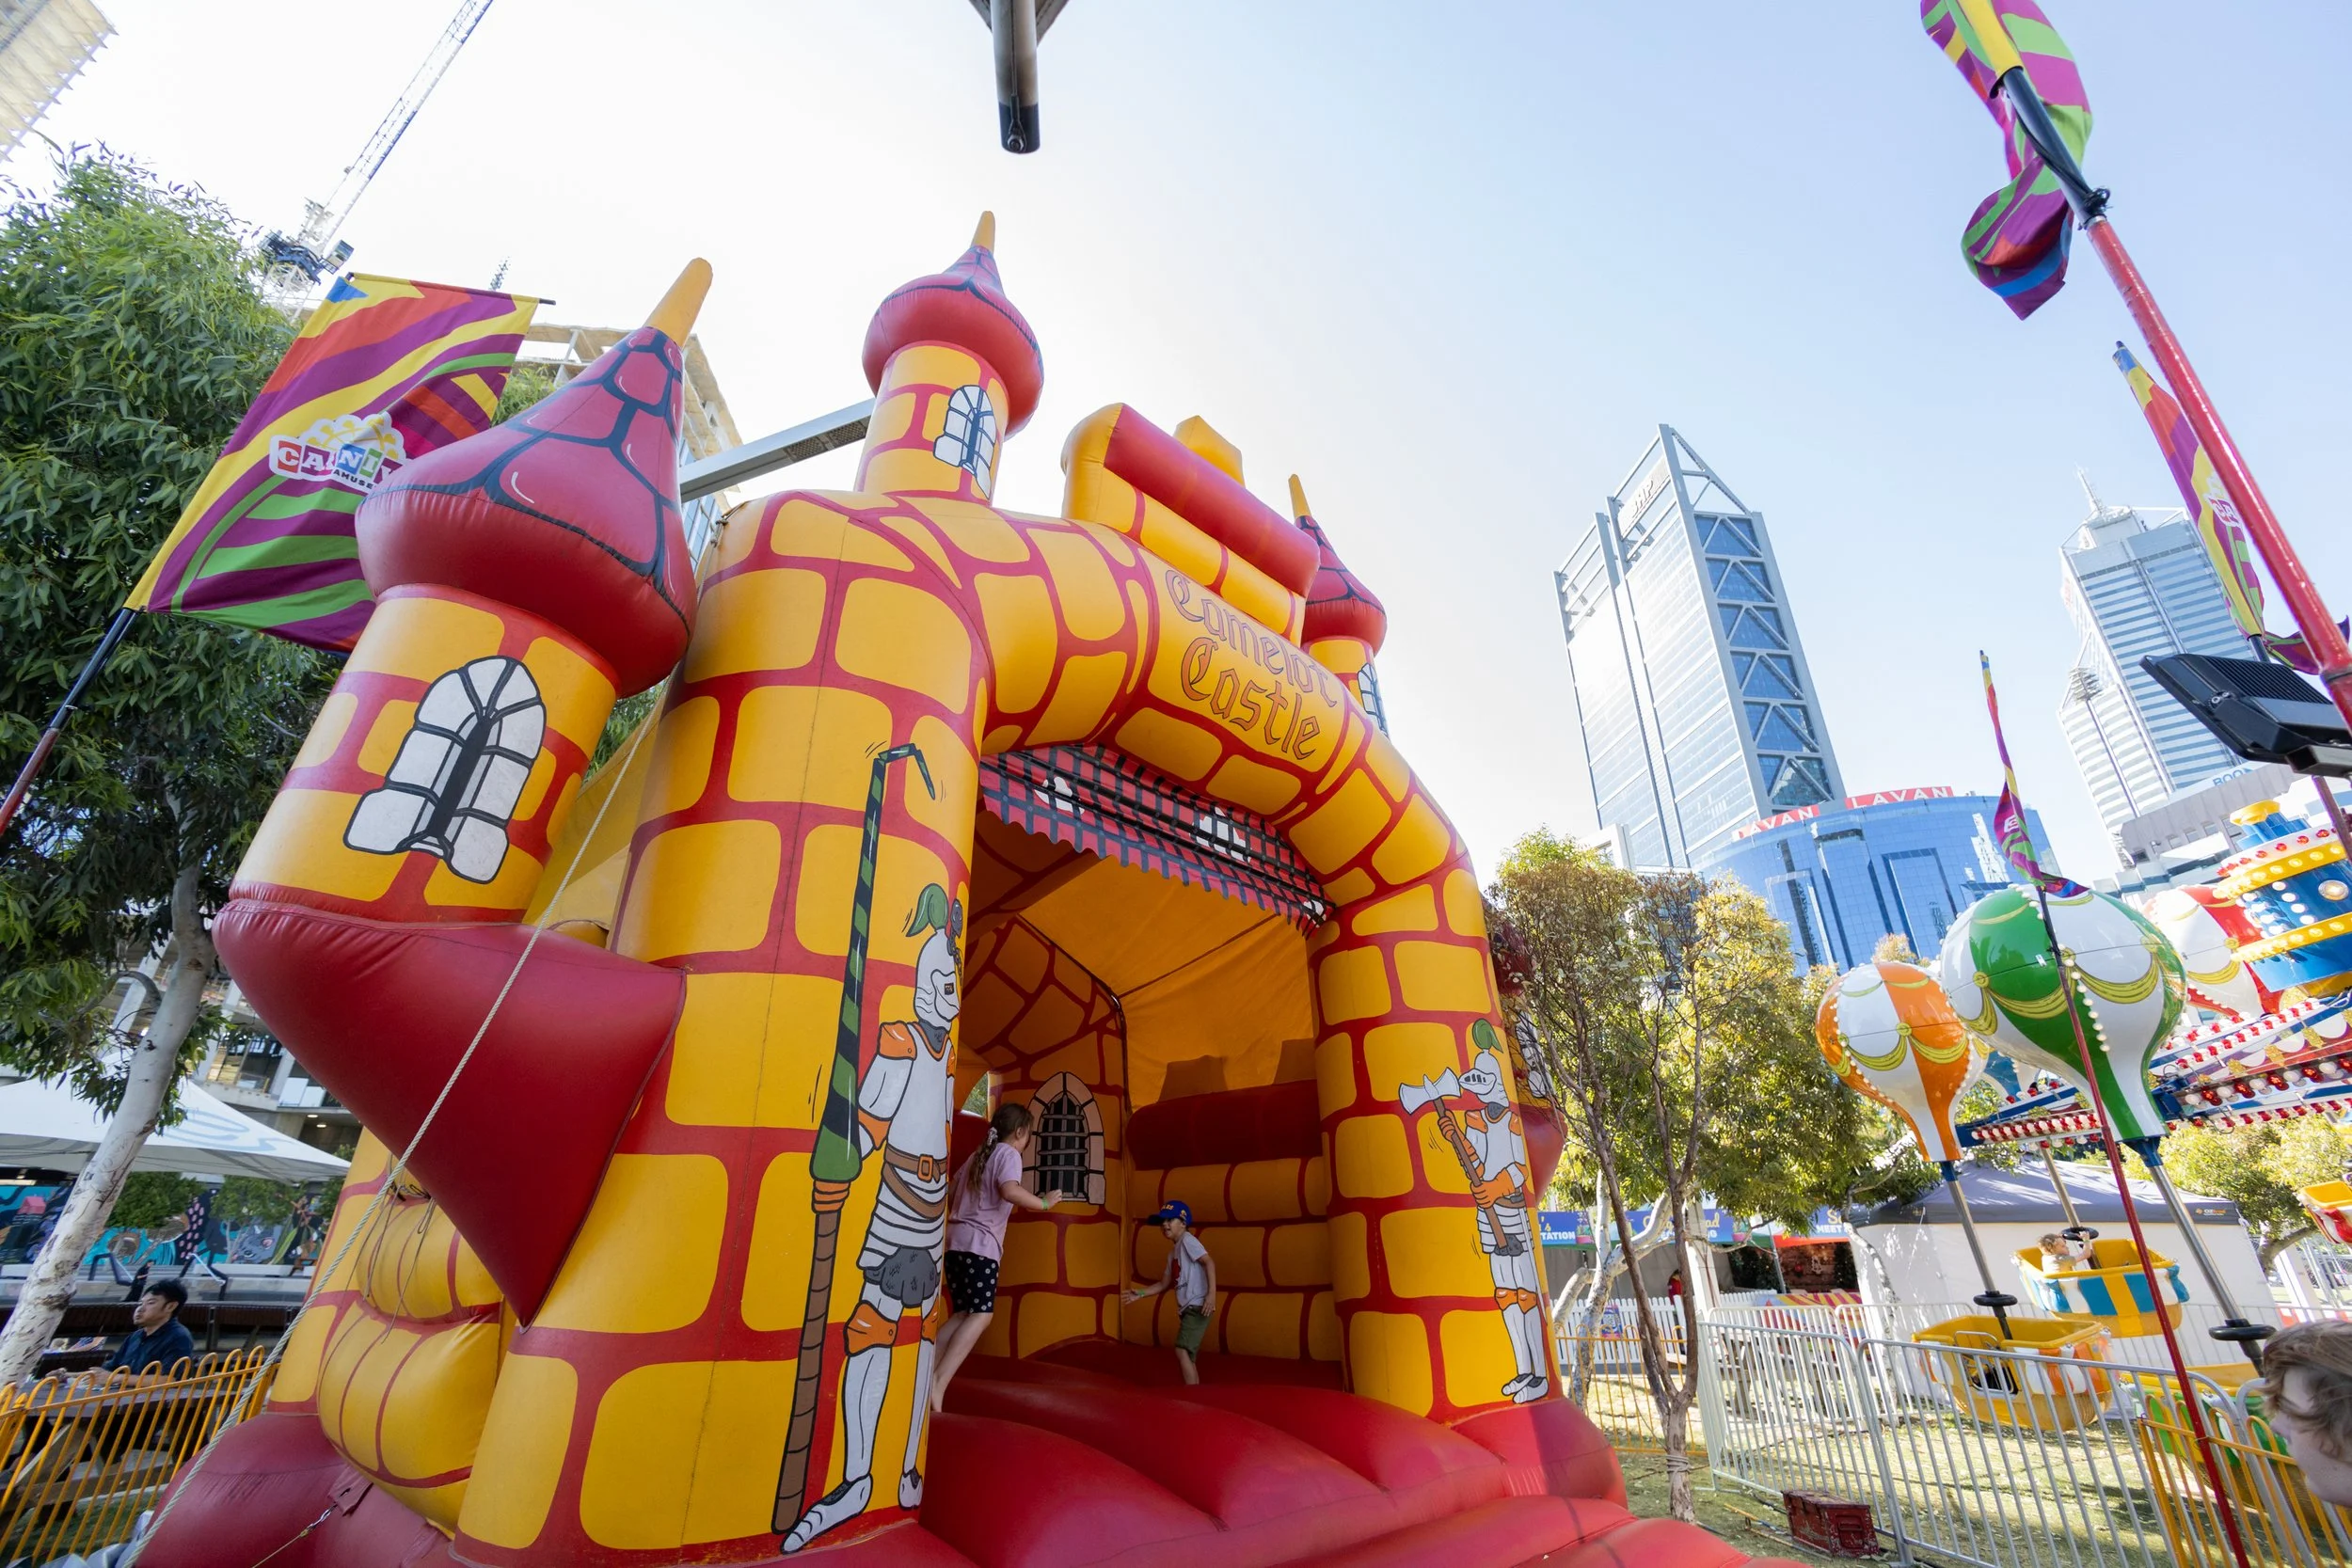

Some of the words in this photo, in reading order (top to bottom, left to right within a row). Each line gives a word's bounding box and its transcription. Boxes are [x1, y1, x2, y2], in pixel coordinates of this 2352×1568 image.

[1165, 569, 1337, 707] Camelot
[1180, 637, 1320, 760] Castle
[1851, 786, 1948, 809] LAVAN
